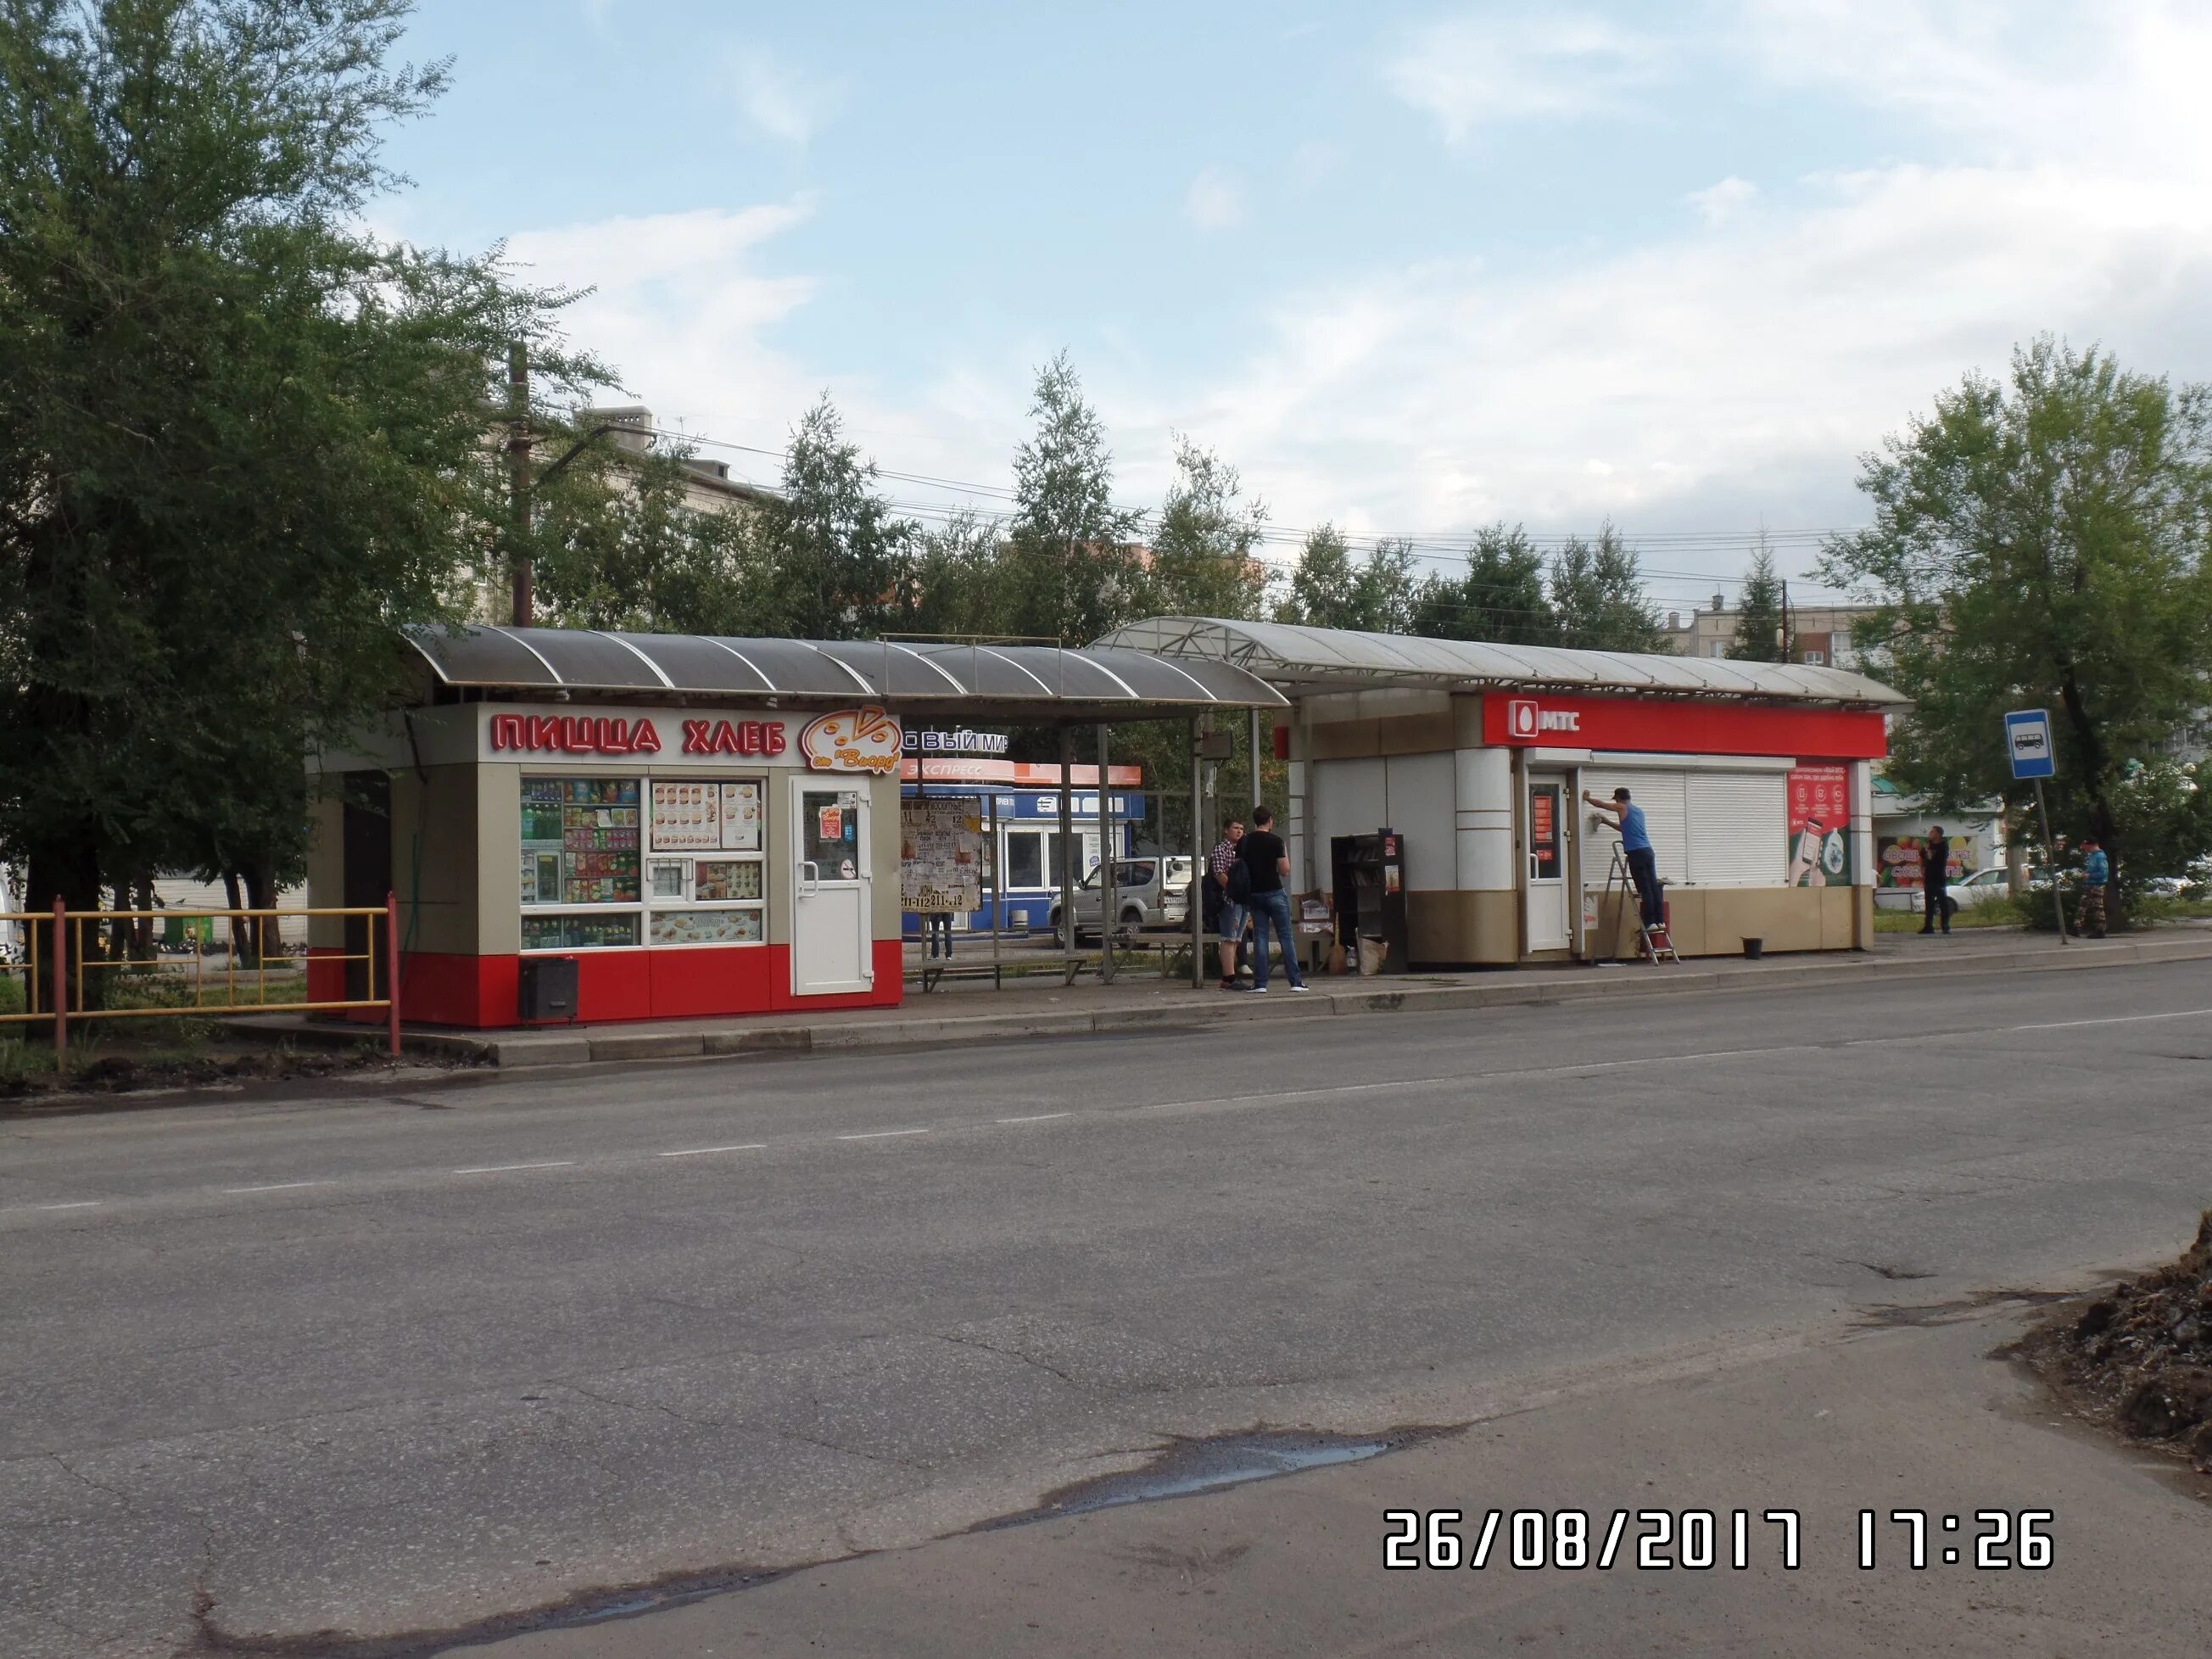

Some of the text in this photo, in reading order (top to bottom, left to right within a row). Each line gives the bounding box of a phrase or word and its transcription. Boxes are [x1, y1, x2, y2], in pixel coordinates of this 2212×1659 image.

[1539, 711, 1579, 730] МТС
[490, 714, 787, 755] ПИЦЦА ХЛЕБ
[902, 729, 977, 751] ОВЫЙ
